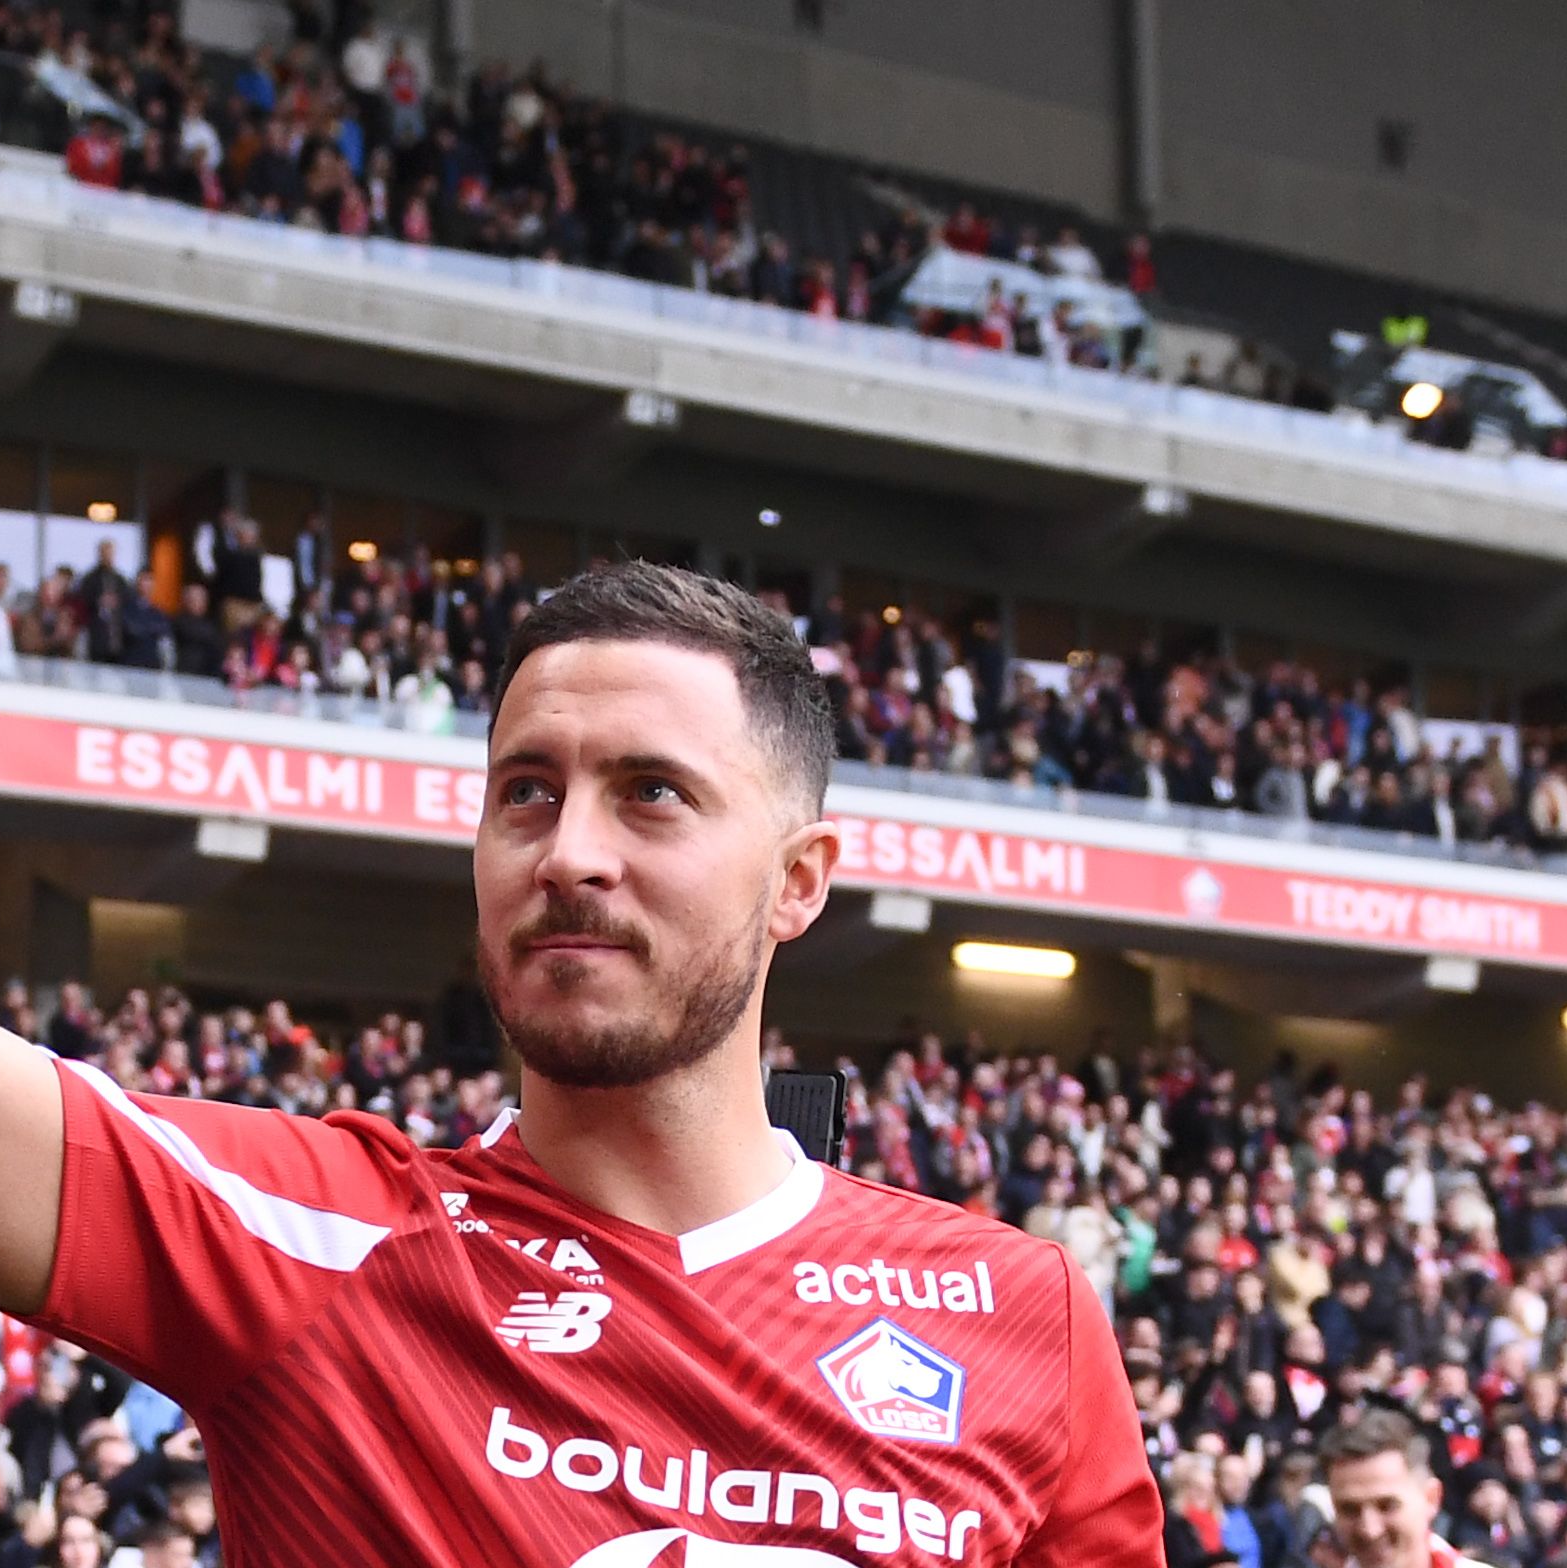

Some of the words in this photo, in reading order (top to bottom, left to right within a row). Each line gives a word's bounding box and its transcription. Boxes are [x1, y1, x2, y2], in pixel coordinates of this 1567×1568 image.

[793, 1259, 995, 1313] actual
[865, 1406, 942, 1433] LOSC
[485, 1406, 982, 1560] boulanger
